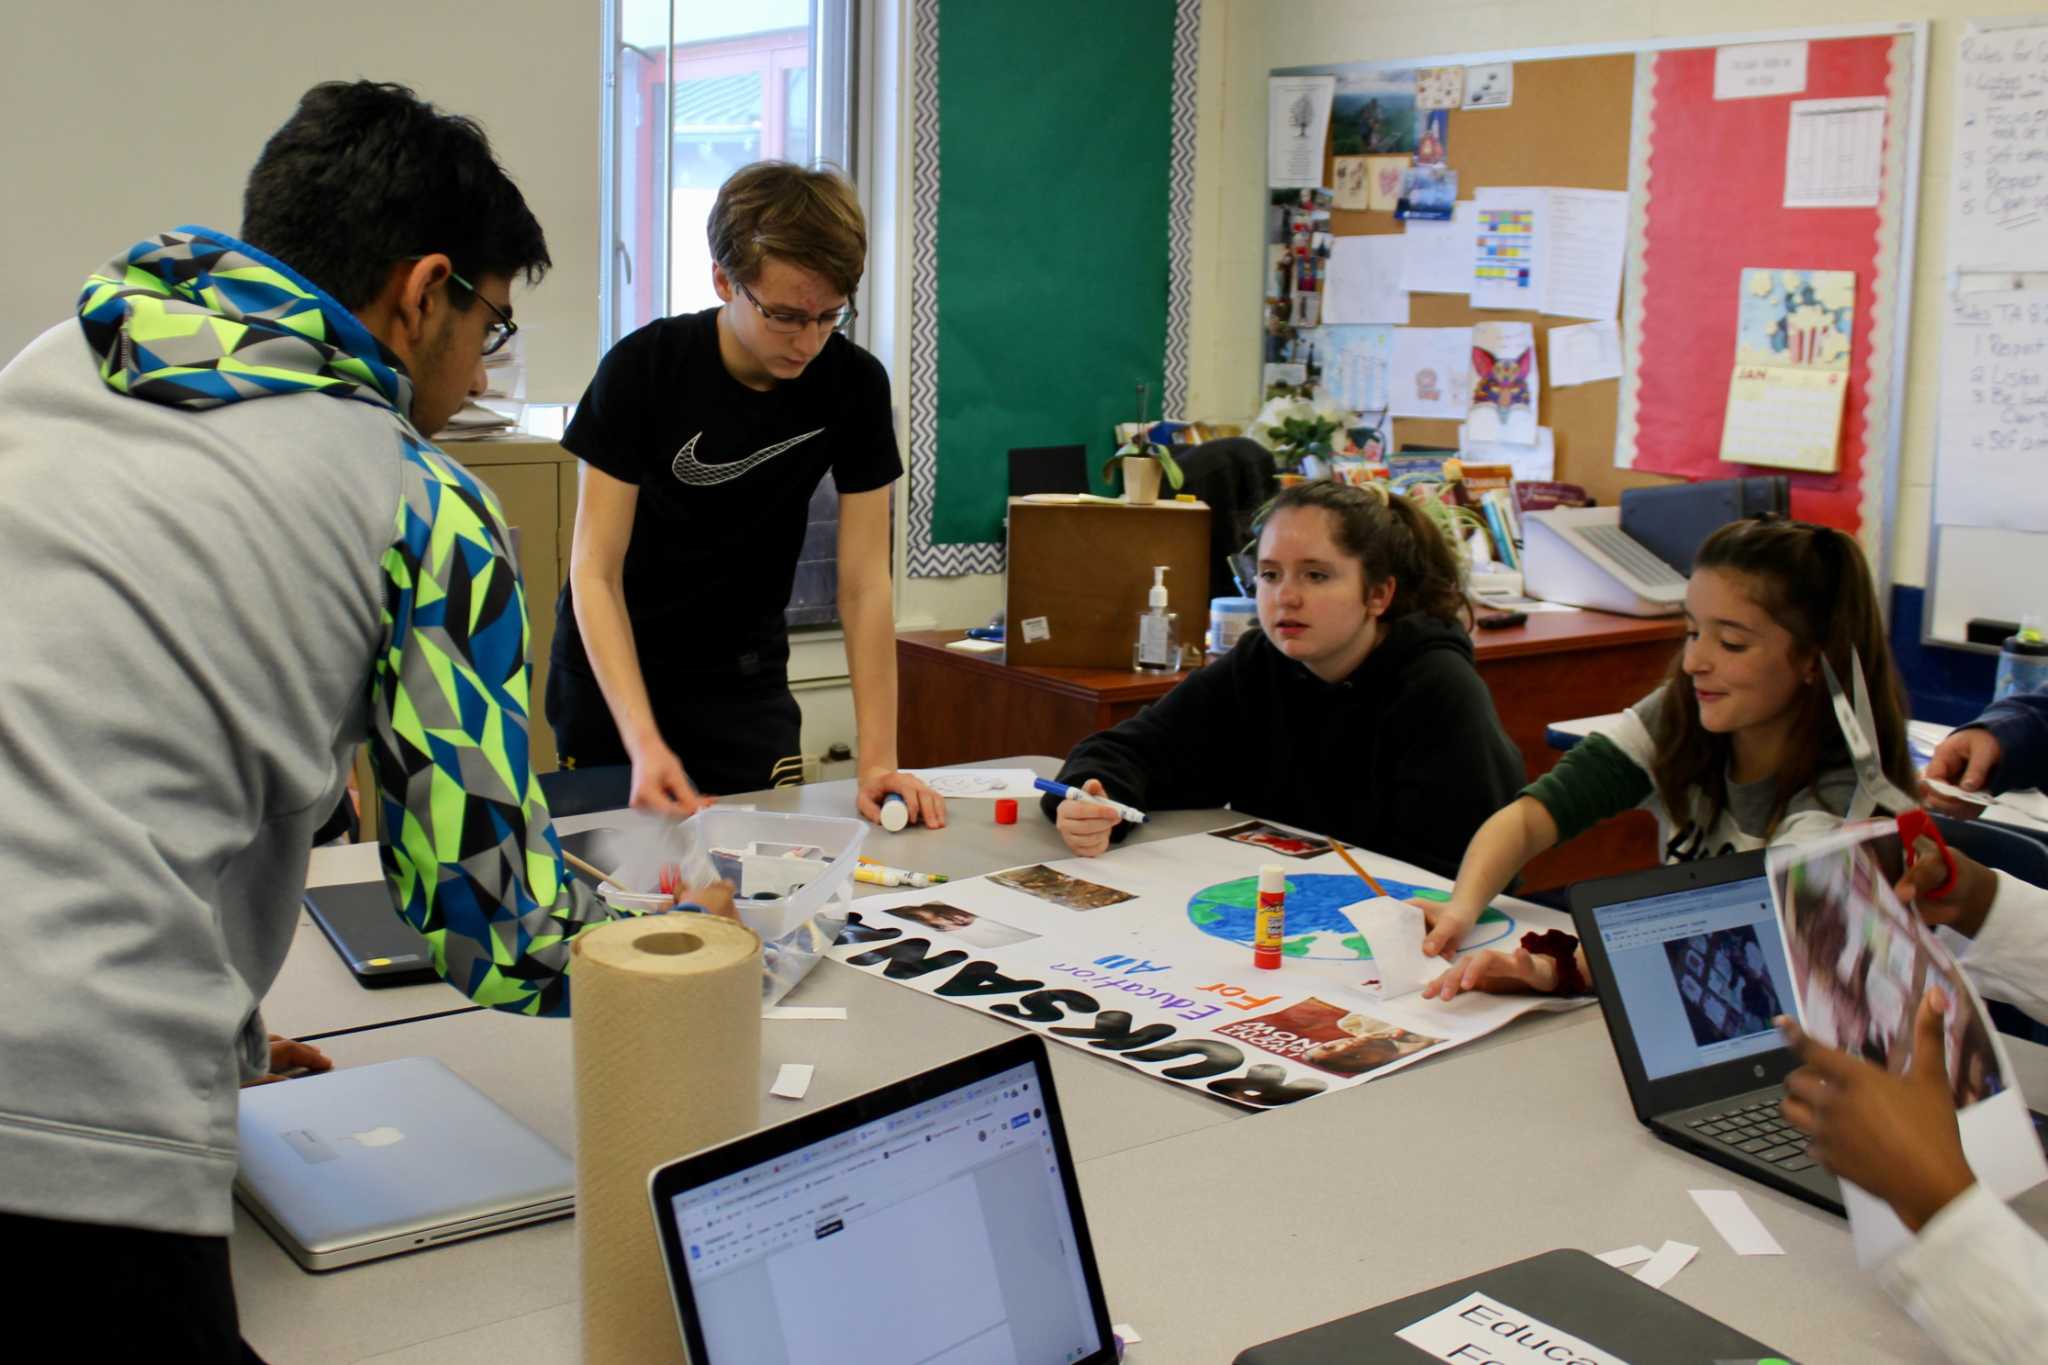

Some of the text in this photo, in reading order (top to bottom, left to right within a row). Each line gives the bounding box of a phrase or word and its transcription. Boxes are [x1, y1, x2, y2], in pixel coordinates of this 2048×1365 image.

[1050, 963, 1223, 1021] Education
[1093, 954, 1283, 1011] For All
[1242, 1022, 1320, 1052] NOW
